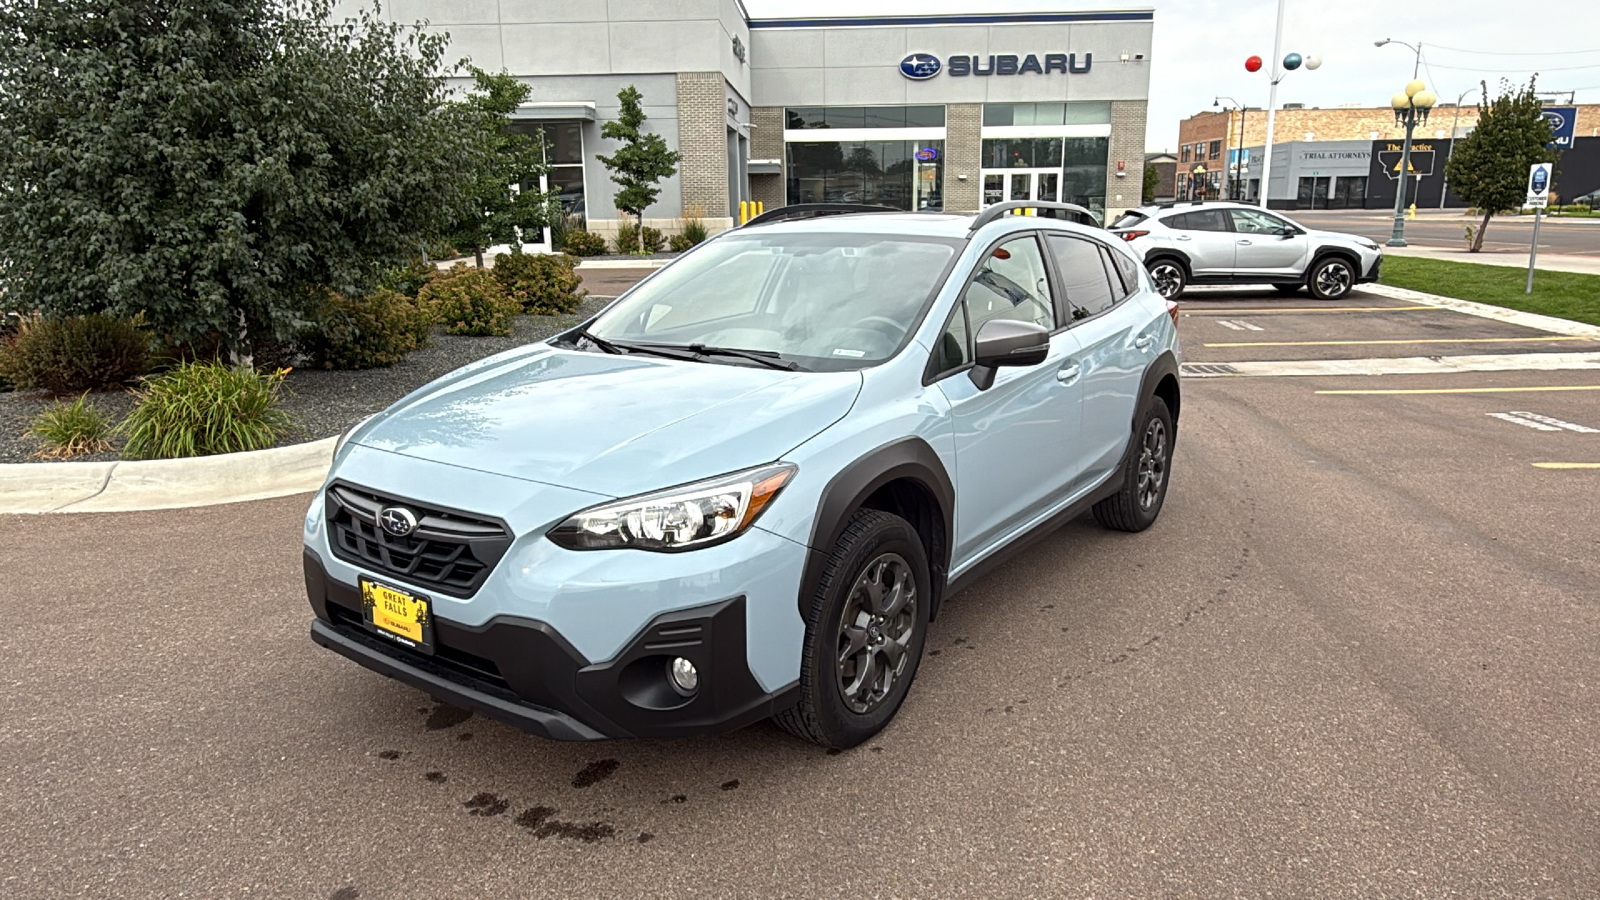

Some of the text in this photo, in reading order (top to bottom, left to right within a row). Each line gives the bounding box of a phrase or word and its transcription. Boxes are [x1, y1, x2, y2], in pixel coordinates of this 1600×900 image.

[948, 53, 1092, 76] SUBARU
[1386, 143, 1432, 151] The actice
[383, 591, 406, 606] GREAT
[384, 601, 408, 617] FALLS
